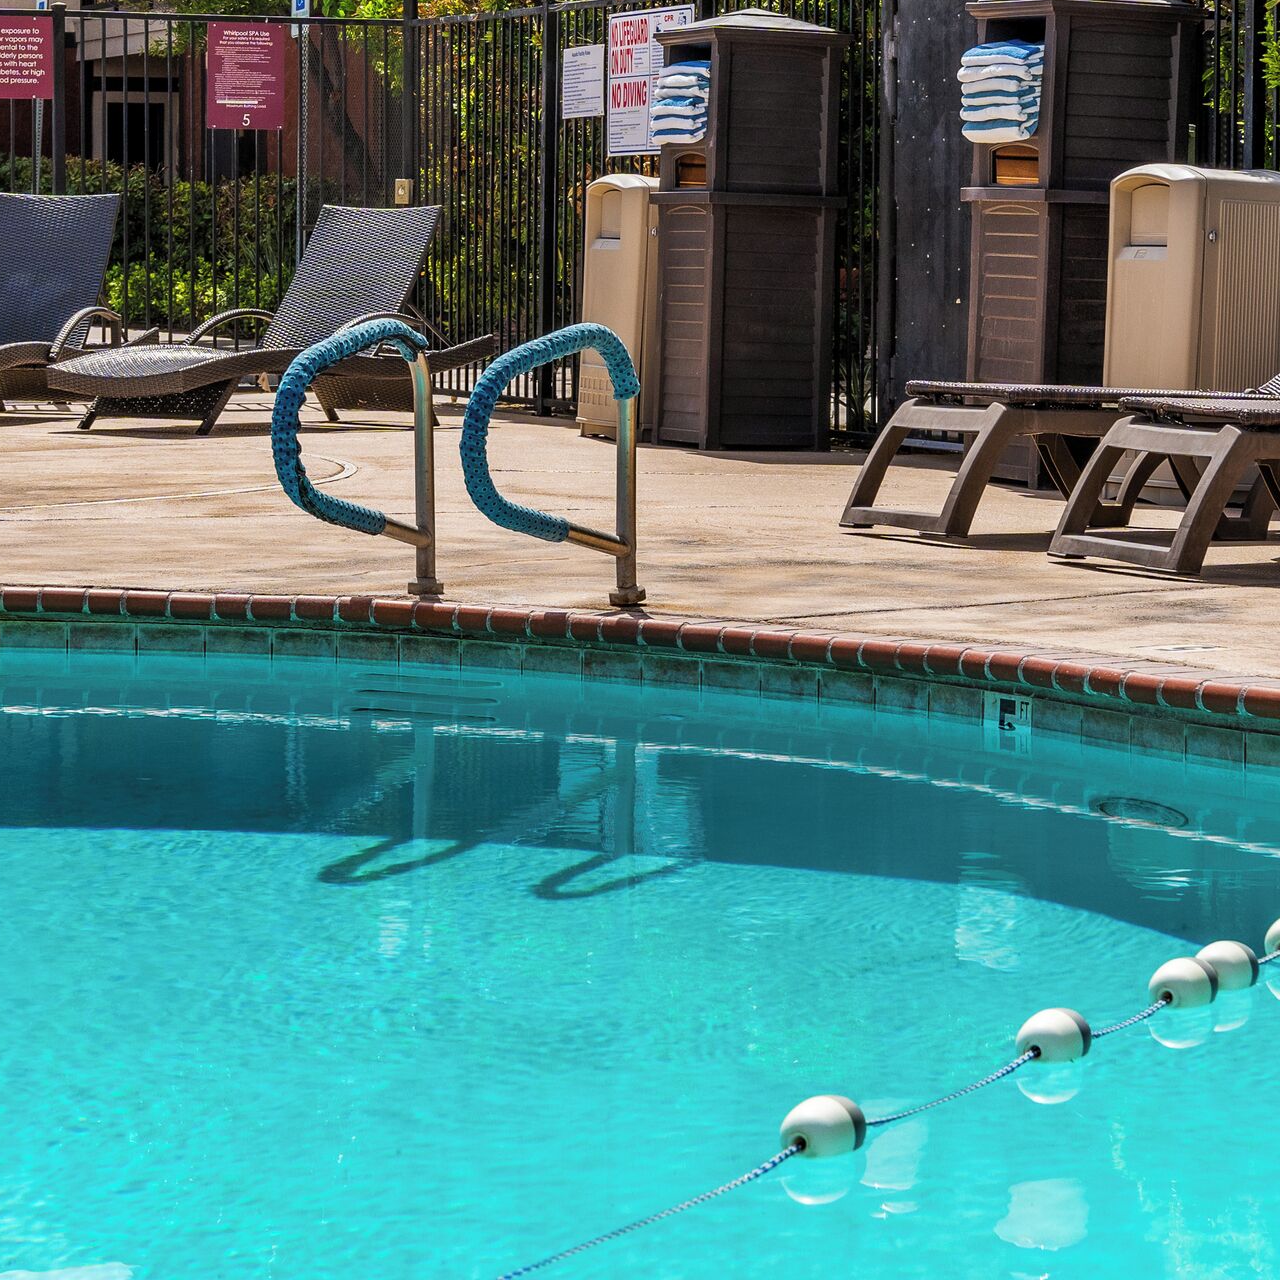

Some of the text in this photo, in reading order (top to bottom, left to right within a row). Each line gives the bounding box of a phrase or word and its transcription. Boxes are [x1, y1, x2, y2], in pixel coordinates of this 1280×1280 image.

[612, 18, 648, 48] NO LIFEGUARD
[612, 50, 618, 75] ON
[620, 48, 633, 74] DUTY
[612, 84, 621, 109] NO
[623, 80, 647, 107] DIVING
[242, 114, 250, 126] 5
[1020, 701, 1029, 720] FT
